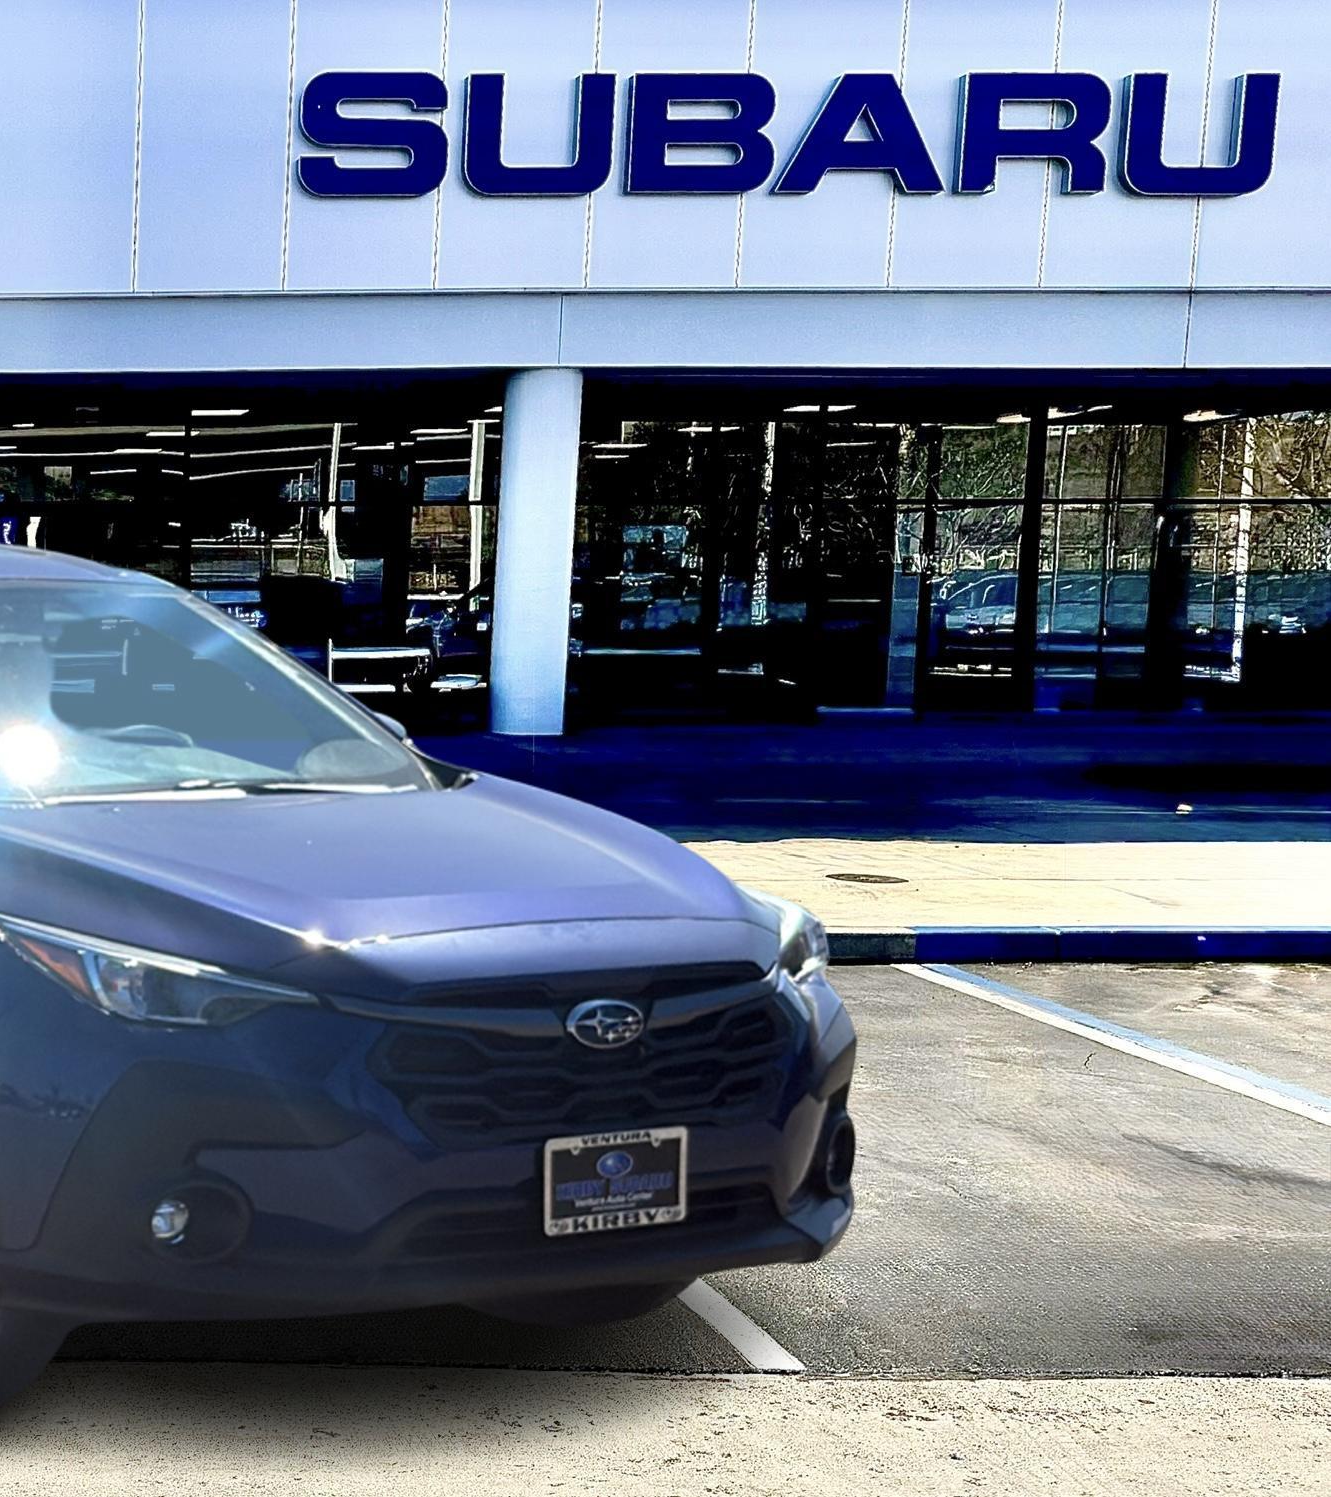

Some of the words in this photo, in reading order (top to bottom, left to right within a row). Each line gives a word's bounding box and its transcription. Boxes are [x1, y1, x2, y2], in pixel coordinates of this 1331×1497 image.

[297, 71, 1280, 196] SUBARU
[581, 1131, 652, 1146] VENTURA
[572, 1210, 660, 1232] KIRBY
